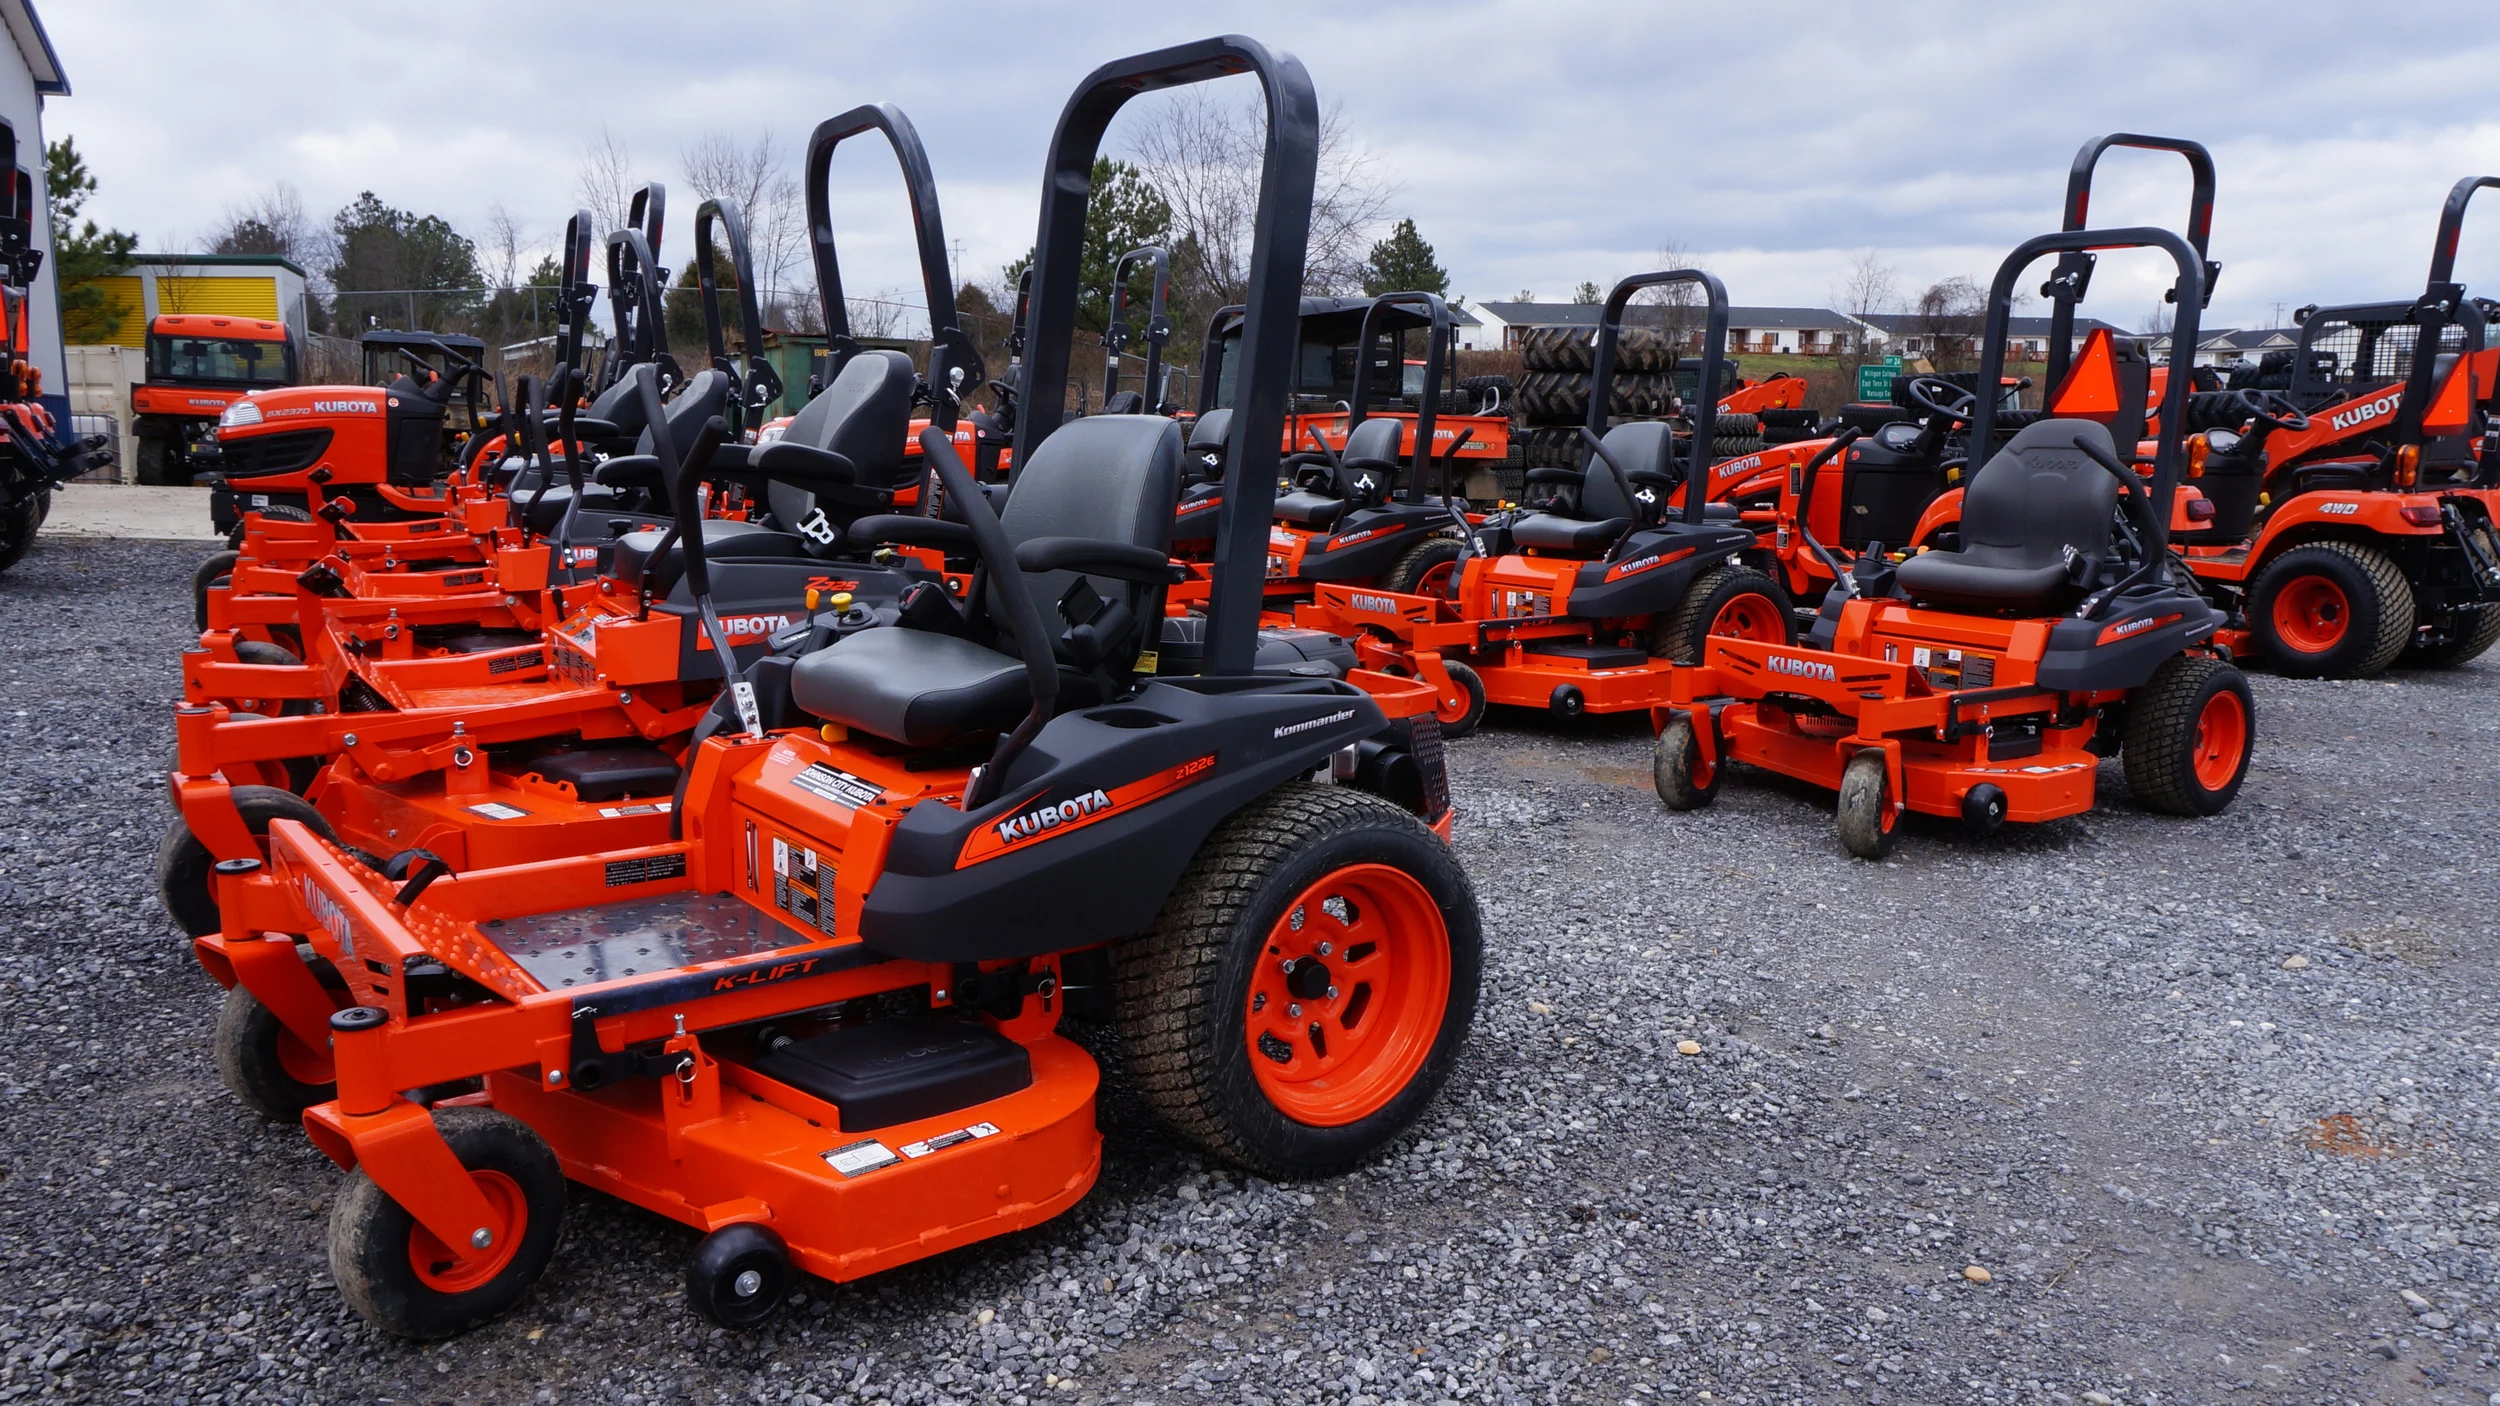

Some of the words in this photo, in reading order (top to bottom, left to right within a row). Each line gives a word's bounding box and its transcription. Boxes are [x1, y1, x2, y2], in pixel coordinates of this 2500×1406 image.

[189, 399, 227, 407] KUBOTA
[266, 408, 311, 418] BX2370
[313, 401, 377, 413] KUBOTA
[2332, 392, 2402, 431] KUBOT
[1719, 455, 1762, 479] KUBOTA
[1180, 499, 1208, 511] KUBOTA
[2318, 502, 2358, 515] 4WD
[1338, 530, 1372, 544] KUBOTA
[1620, 555, 1660, 574] KUBOTA
[804, 576, 859, 592] Z725
[1351, 593, 1397, 615] KUBOTA
[2116, 617, 2154, 635] KUBOTA
[1768, 655, 1836, 682] KUBOTA
[1273, 708, 1356, 739] Kommander
[801, 767, 837, 785] JOHNSON
[831, 779, 851, 792] CITY
[845, 784, 876, 803] KUBOTA
[998, 789, 1113, 843] KUBOTA
[303, 872, 356, 963] KUBOTA
[714, 958, 819, 991] K-LIFT
